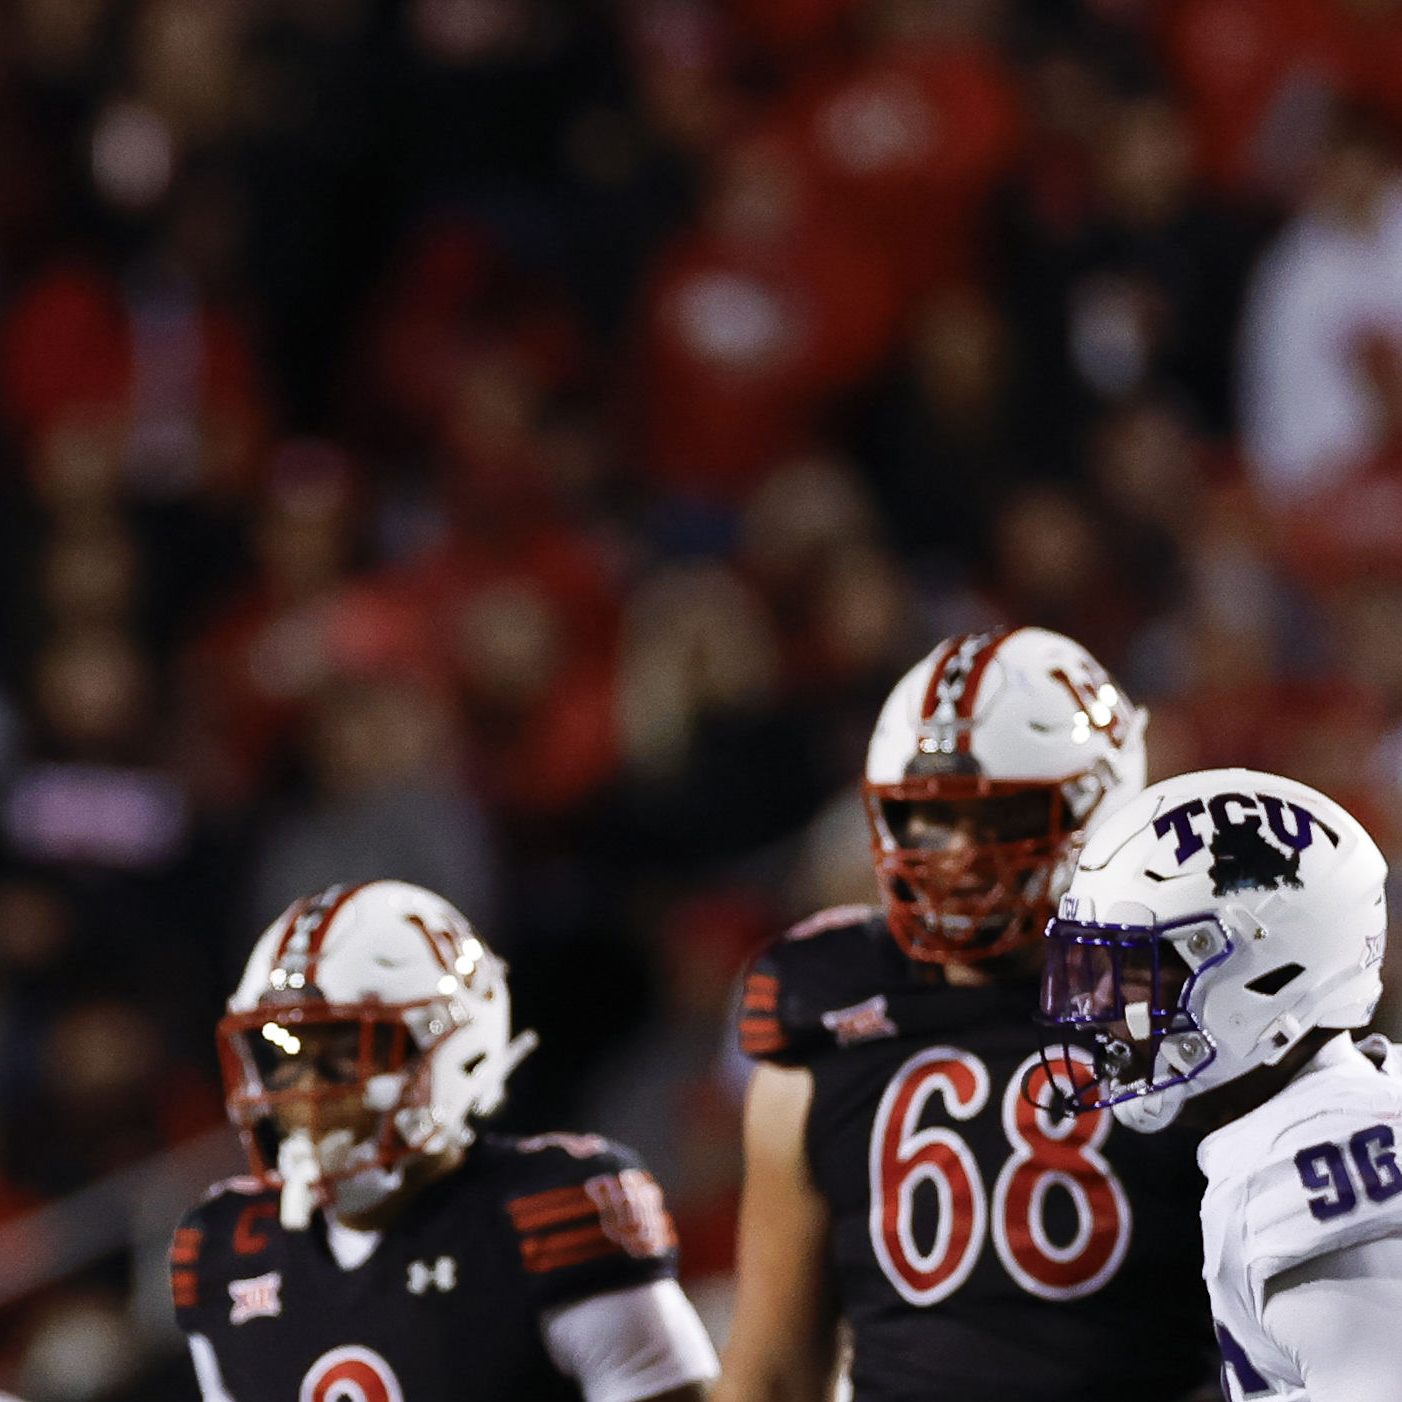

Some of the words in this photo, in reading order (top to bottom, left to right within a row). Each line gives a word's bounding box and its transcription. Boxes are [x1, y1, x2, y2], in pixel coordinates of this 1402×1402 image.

[1153, 792, 1314, 866] TCU
[869, 1044, 1133, 1307] 68
[1294, 1124, 1402, 1223] 96
